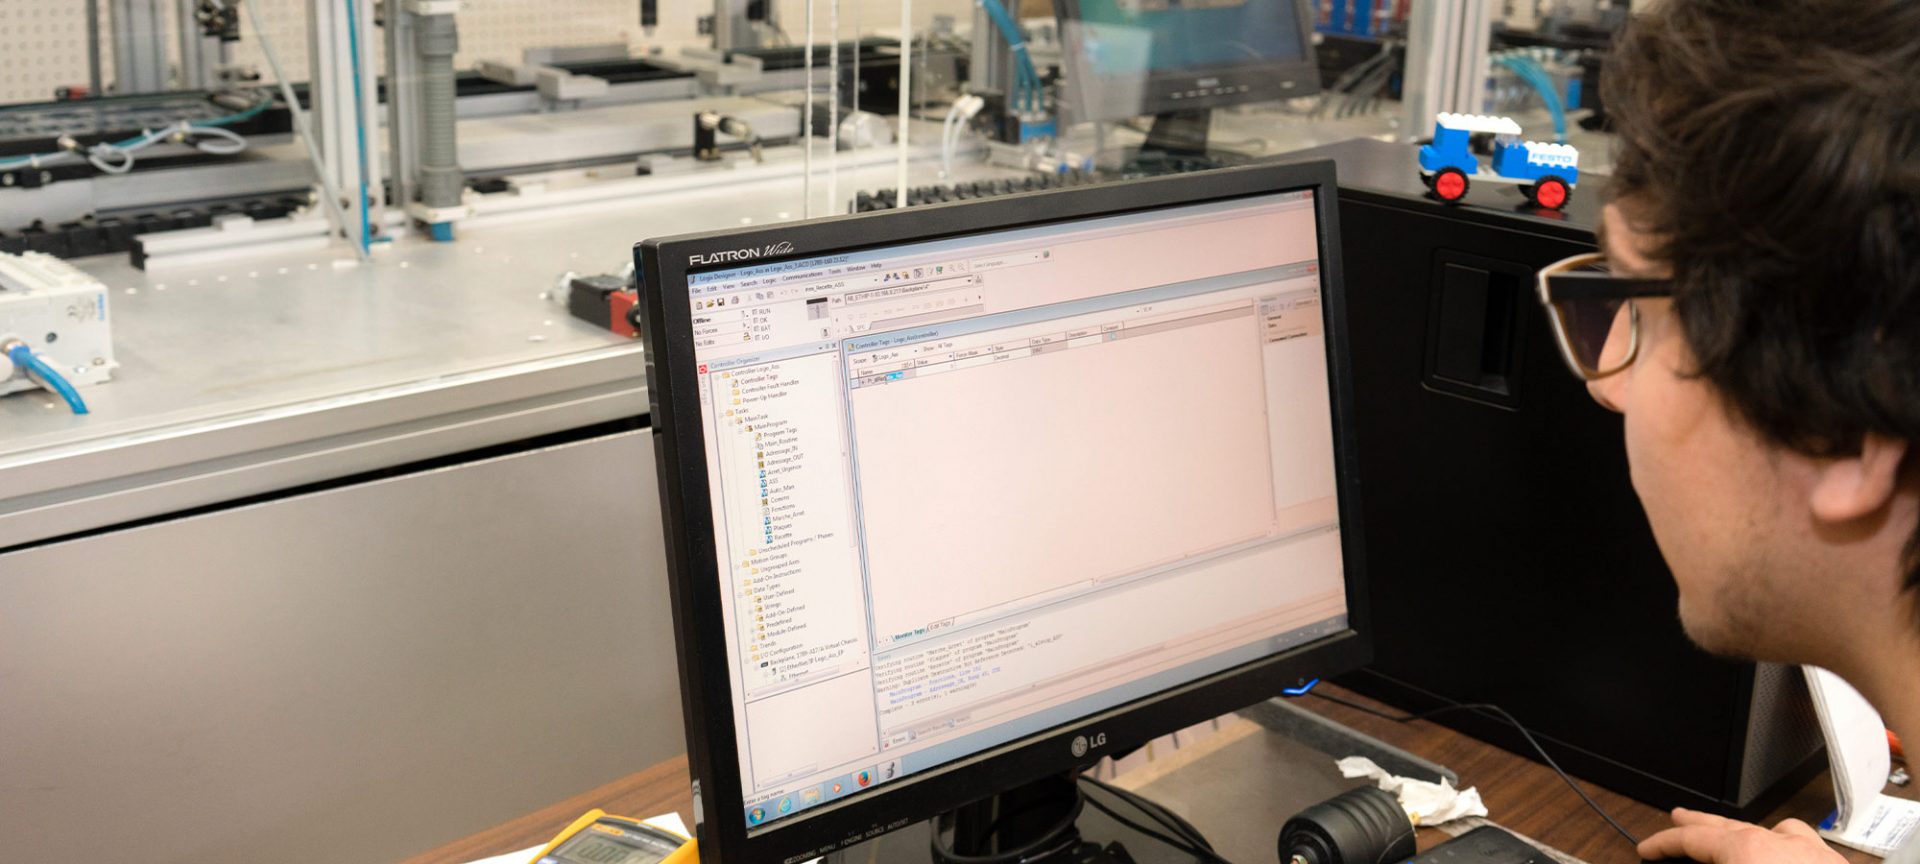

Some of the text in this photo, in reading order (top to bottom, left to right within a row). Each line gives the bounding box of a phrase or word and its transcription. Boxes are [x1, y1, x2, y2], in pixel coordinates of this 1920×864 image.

[1532, 152, 1572, 163] FESTO
[689, 241, 794, 266] FLATRON Wide
[762, 276, 776, 286] Logic
[782, 270, 823, 282] Communications
[847, 264, 866, 272] Window
[871, 262, 882, 270] Help
[758, 308, 771, 316] RUN
[692, 316, 712, 324] Offline
[702, 327, 718, 335] Forces
[856, 340, 878, 350] Controller
[731, 369, 756, 378] Controller
[741, 376, 765, 386] Controller
[742, 386, 766, 395] Controller
[764, 430, 785, 438] Program
[758, 542, 790, 554] Unscheduled
[766, 617, 792, 628] Predefined
[914, 628, 926, 636] Tags
[974, 632, 996, 643] program
[769, 643, 803, 657] Configuration
[962, 642, 983, 653] program
[1090, 732, 1106, 750] LG
